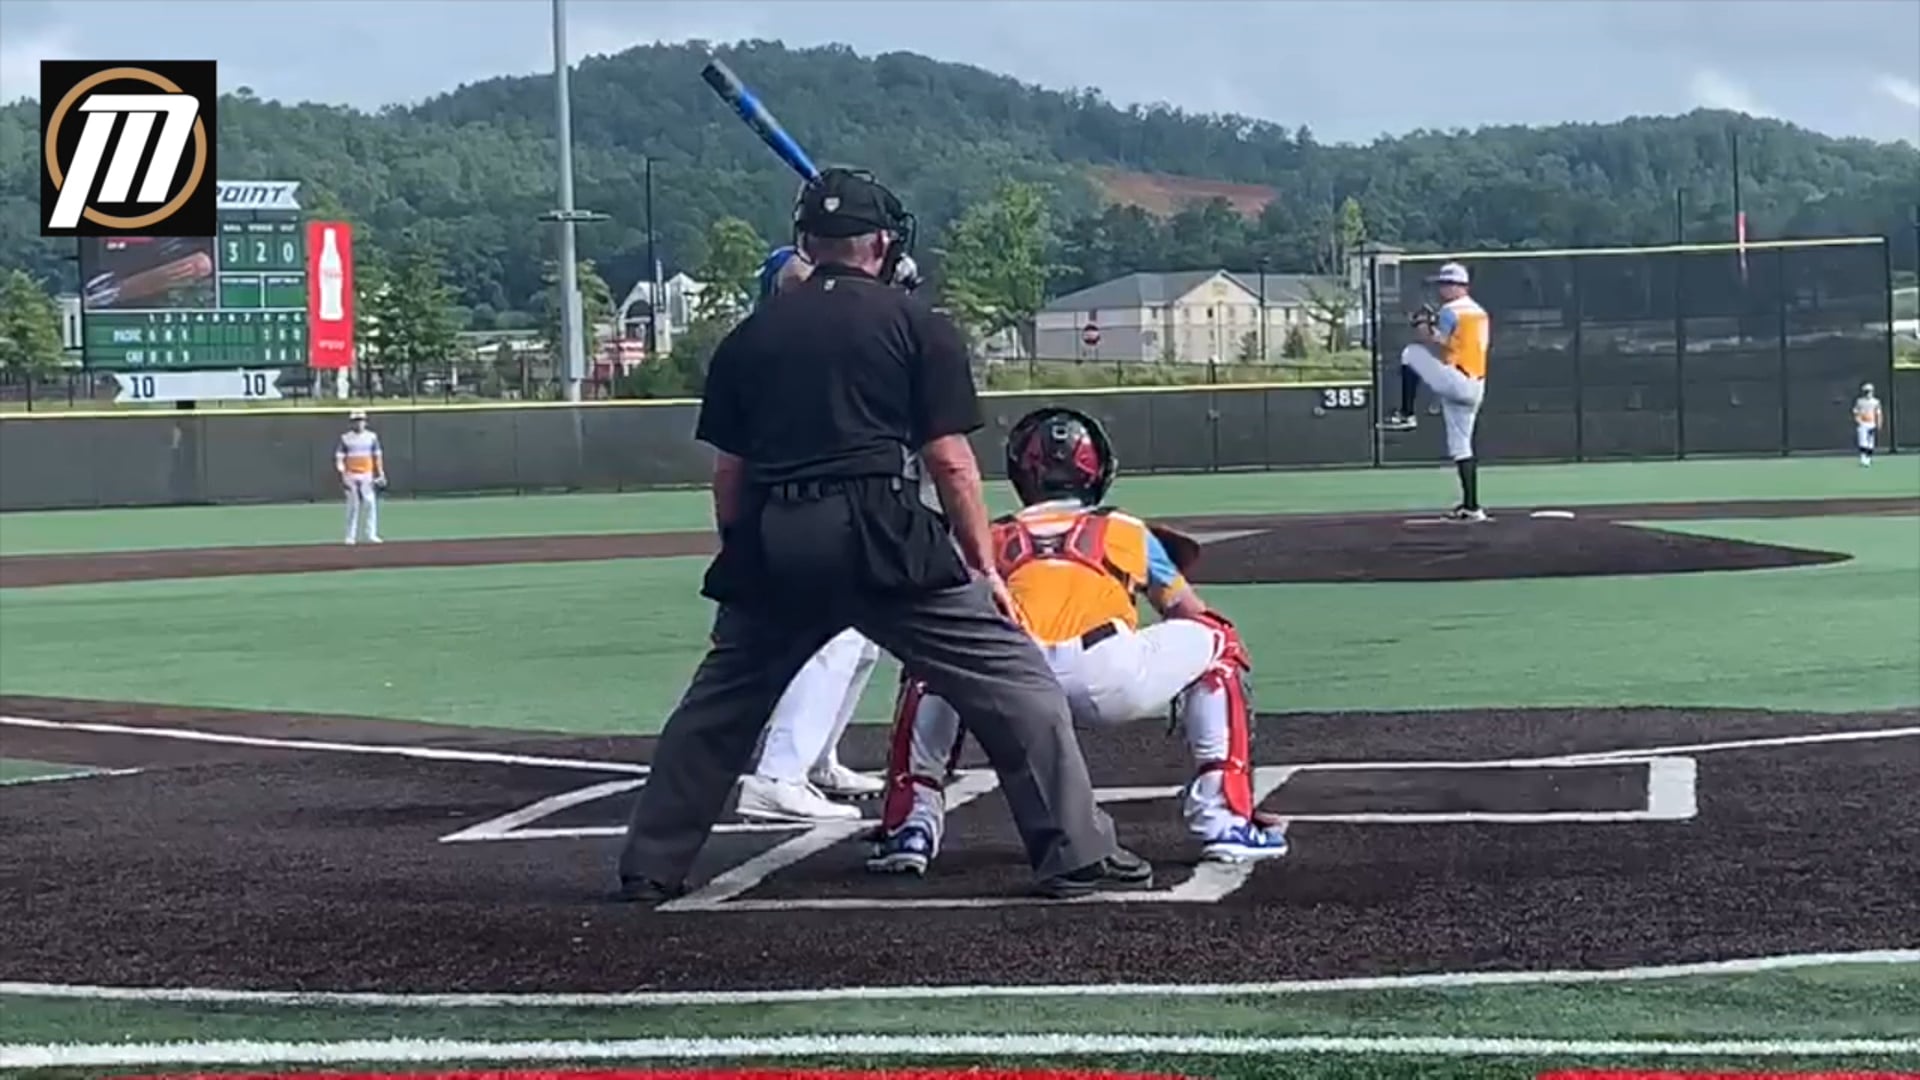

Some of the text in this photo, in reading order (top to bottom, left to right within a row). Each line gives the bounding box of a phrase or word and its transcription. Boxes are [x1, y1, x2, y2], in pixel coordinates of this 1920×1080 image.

[228, 241, 294, 263] 3 2 0
[130, 373, 266, 398] 10 10
[1323, 389, 1366, 407] 385
